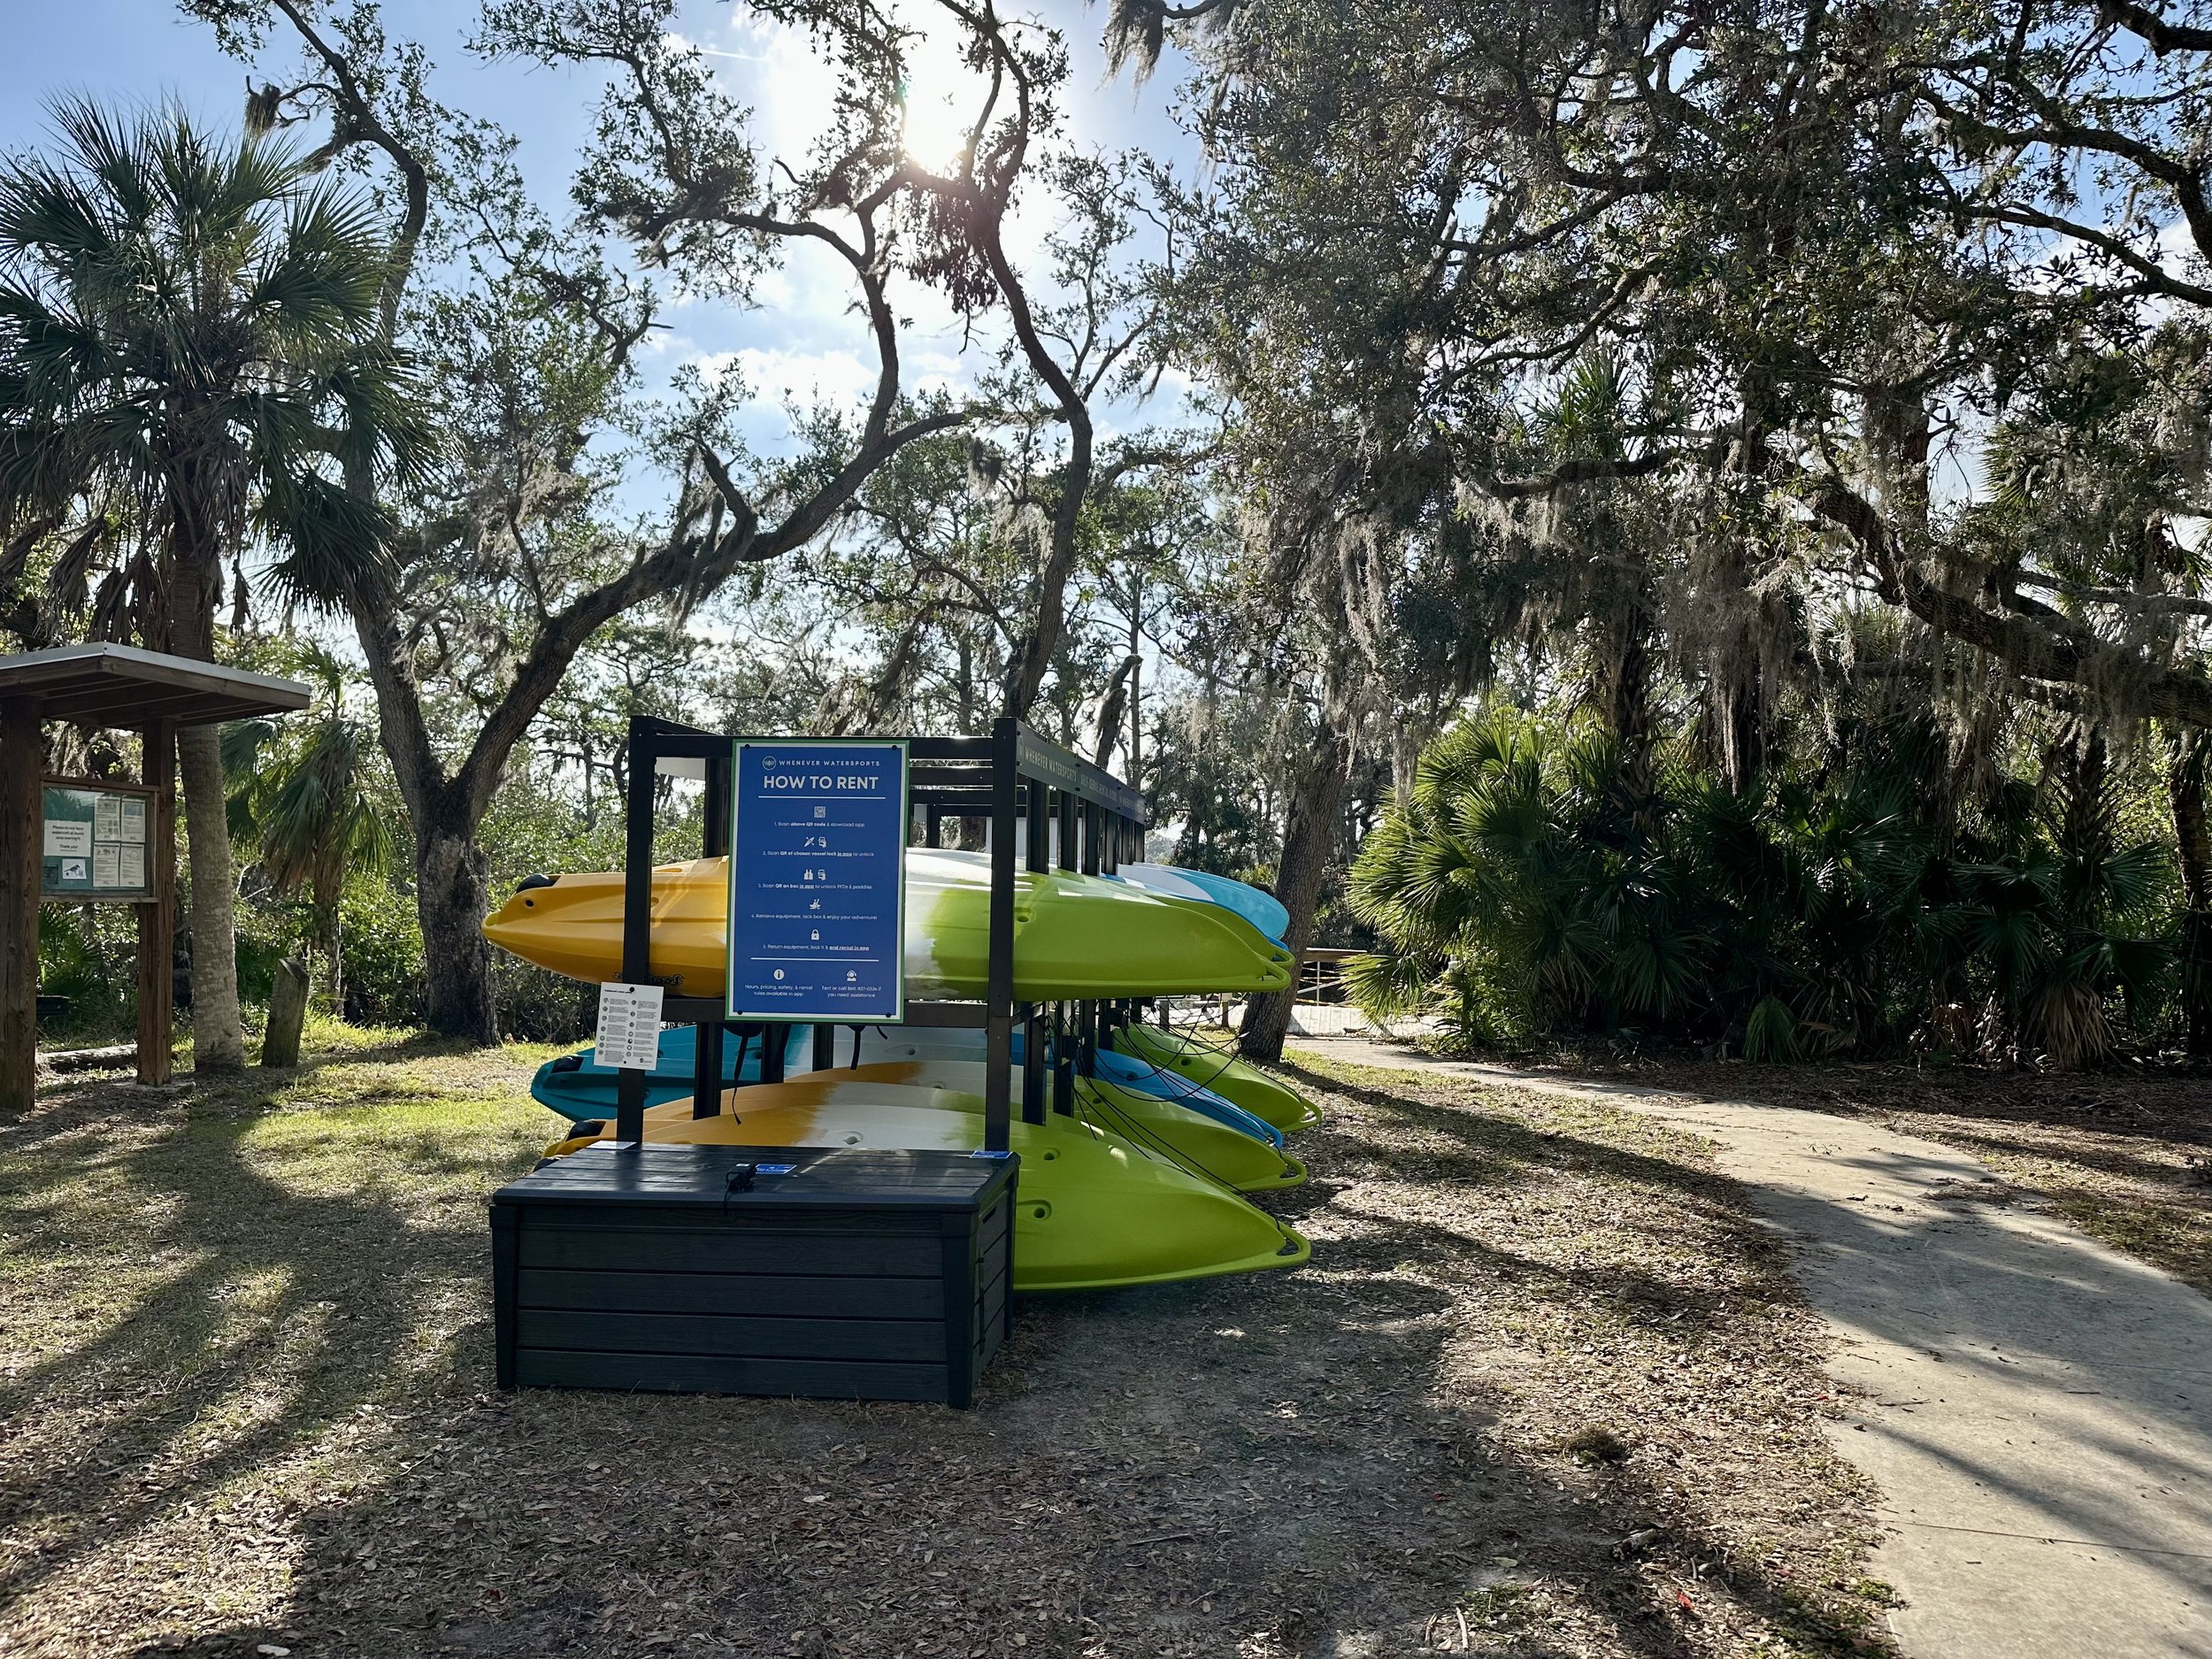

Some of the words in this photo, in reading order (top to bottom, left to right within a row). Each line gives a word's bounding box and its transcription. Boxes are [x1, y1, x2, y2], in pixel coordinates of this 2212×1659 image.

[1025, 745, 1048, 770] WHENEVER
[1049, 759, 1076, 782] WATERSPORTS
[764, 775, 806, 789] HOW
[810, 776, 832, 789] TO
[837, 776, 879, 790] RENT
